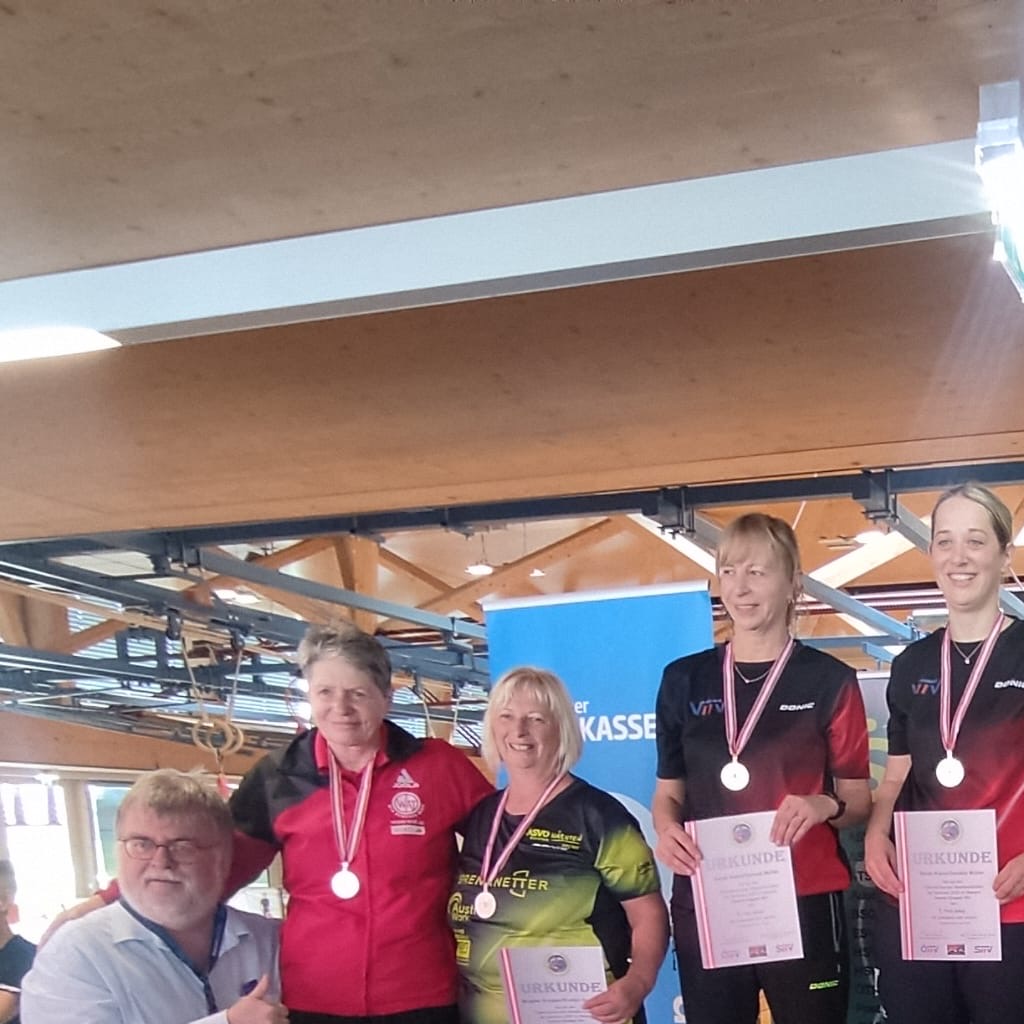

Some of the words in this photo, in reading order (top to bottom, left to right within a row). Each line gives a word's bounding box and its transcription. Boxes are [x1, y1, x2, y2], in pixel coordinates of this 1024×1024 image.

[704, 849, 786, 871] URKUNDE
[912, 850, 993, 865] URKUNDE
[520, 982, 603, 994] URKUNDE
